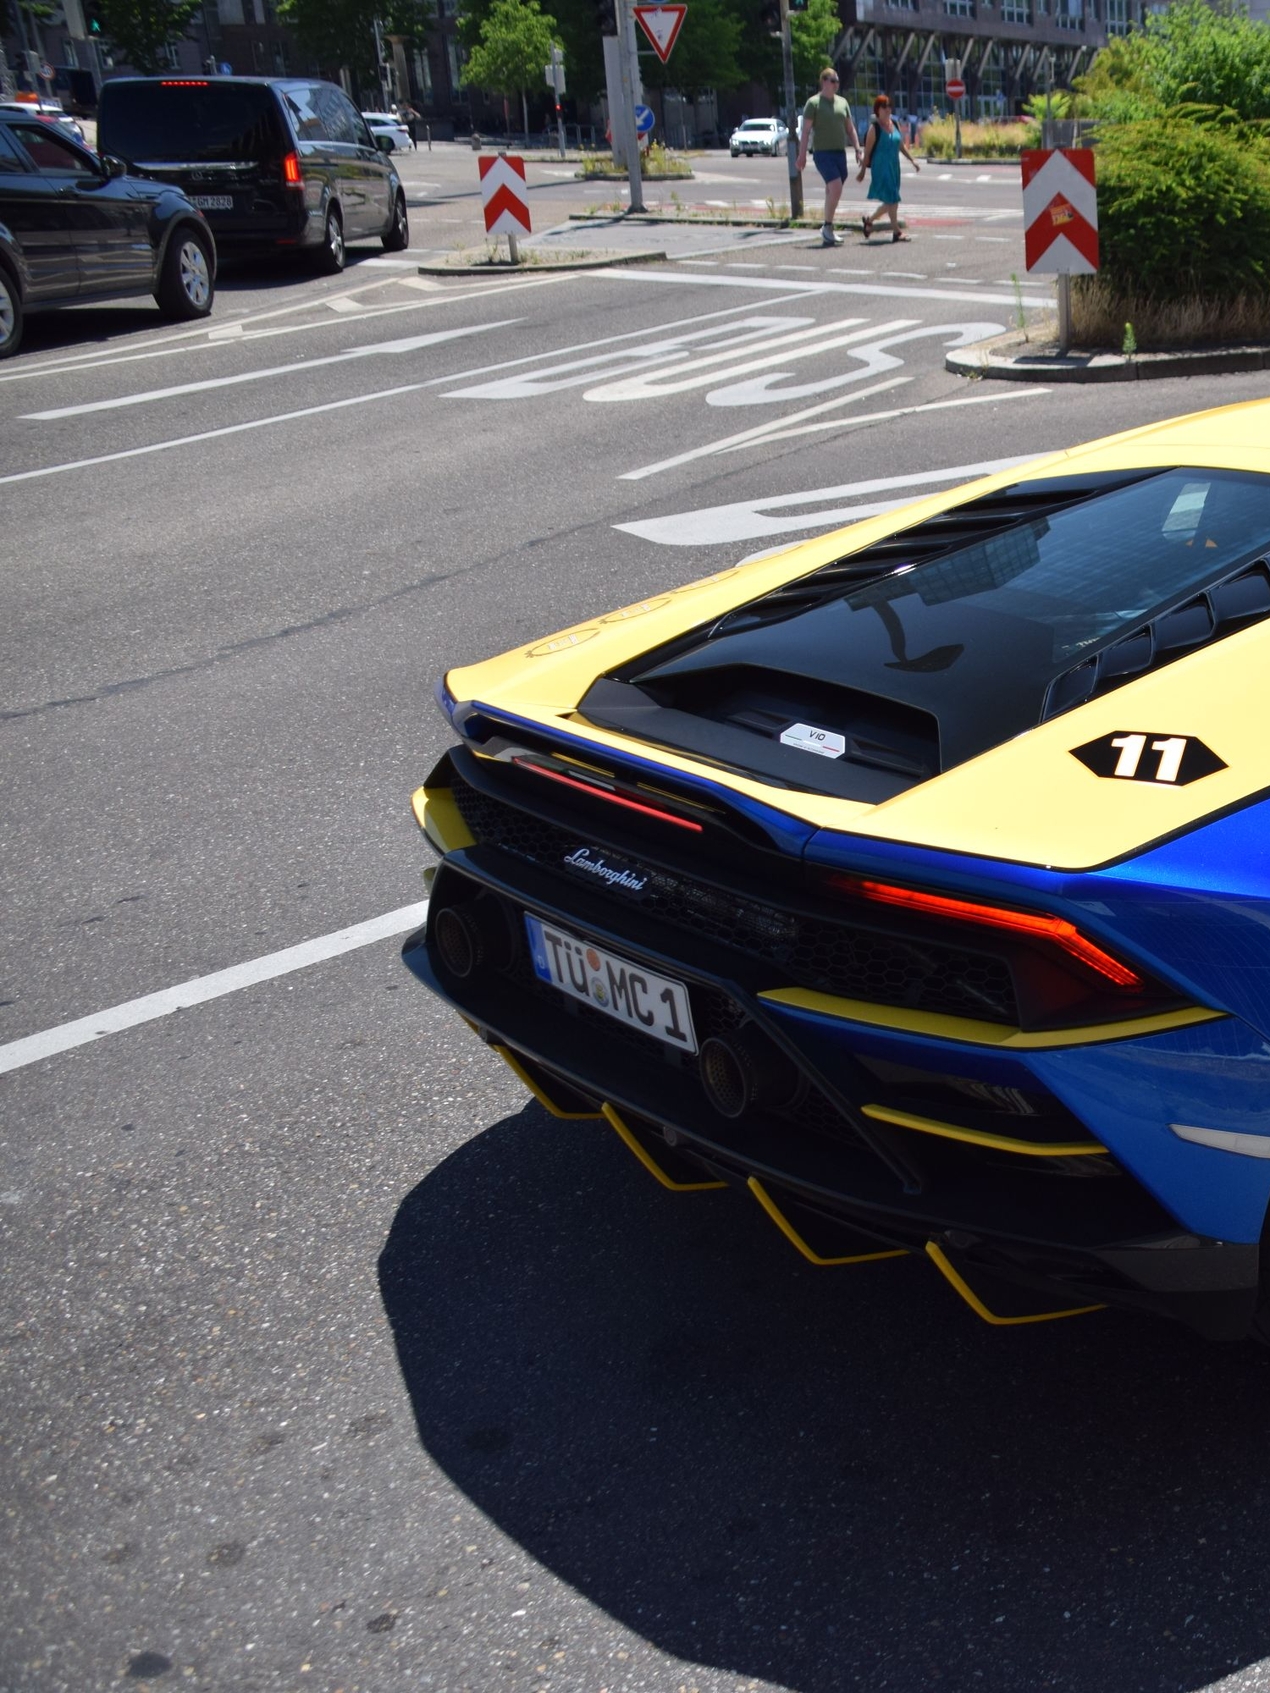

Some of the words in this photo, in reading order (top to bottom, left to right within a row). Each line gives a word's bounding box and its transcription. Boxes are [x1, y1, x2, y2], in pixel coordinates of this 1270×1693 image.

[440, 316, 1006, 406] BUS
[1111, 734, 1187, 782] 11
[564, 848, 647, 892] Lamborghini
[545, 932, 590, 997] TÜ
[606, 960, 654, 1027] MC
[660, 988, 687, 1042] 1
